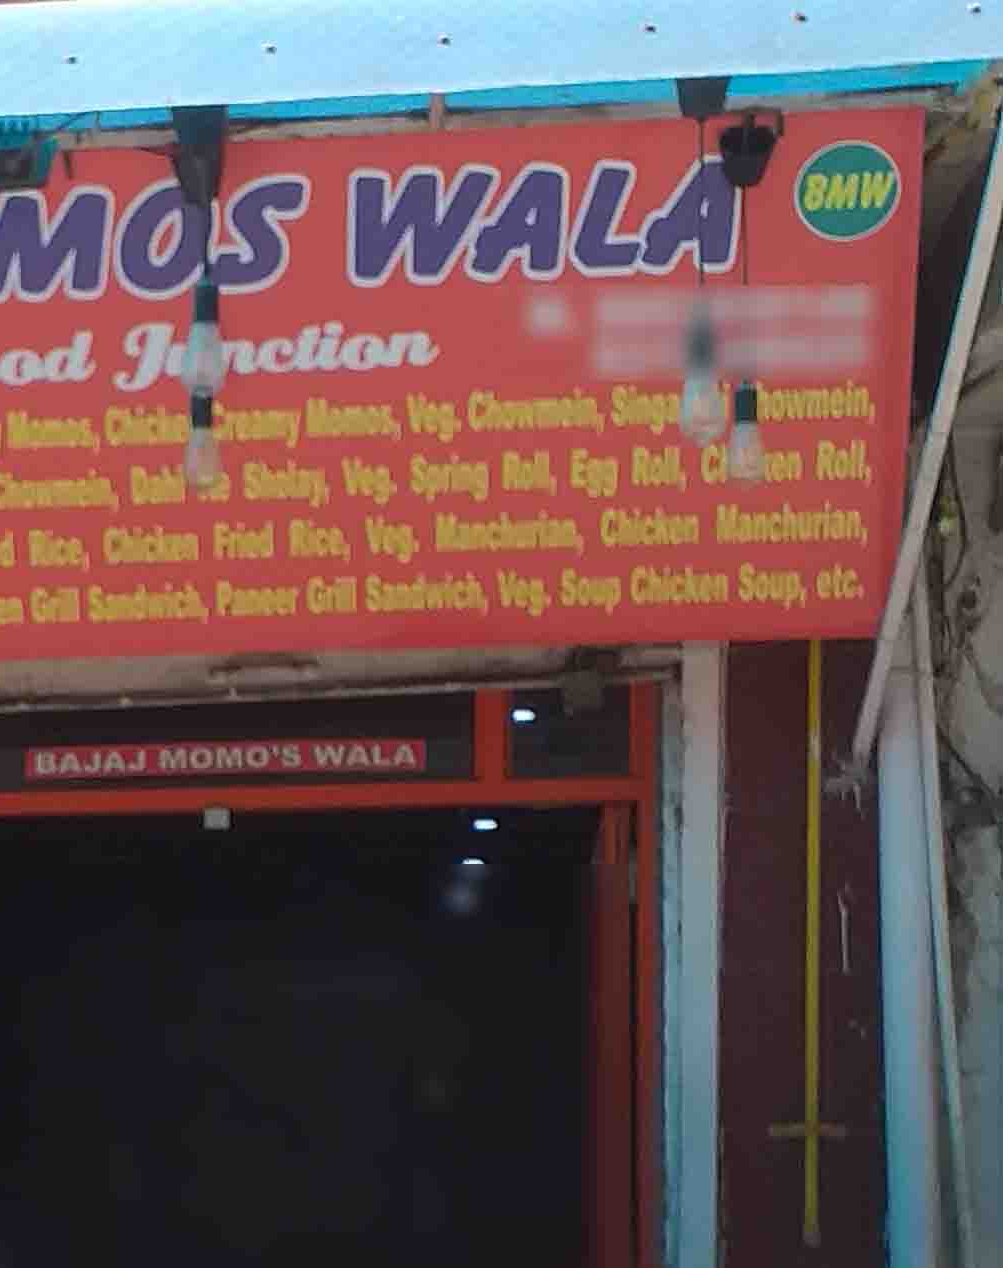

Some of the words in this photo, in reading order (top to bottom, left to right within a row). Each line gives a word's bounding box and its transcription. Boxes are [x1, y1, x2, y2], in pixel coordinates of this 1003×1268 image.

[802, 169, 895, 213] BMW
[346, 158, 745, 290] WALA
[570, 448, 620, 498] Egg
[33, 749, 147, 776] BAJAJ
[157, 744, 303, 772] MOMO'S
[312, 741, 419, 769] WALA
